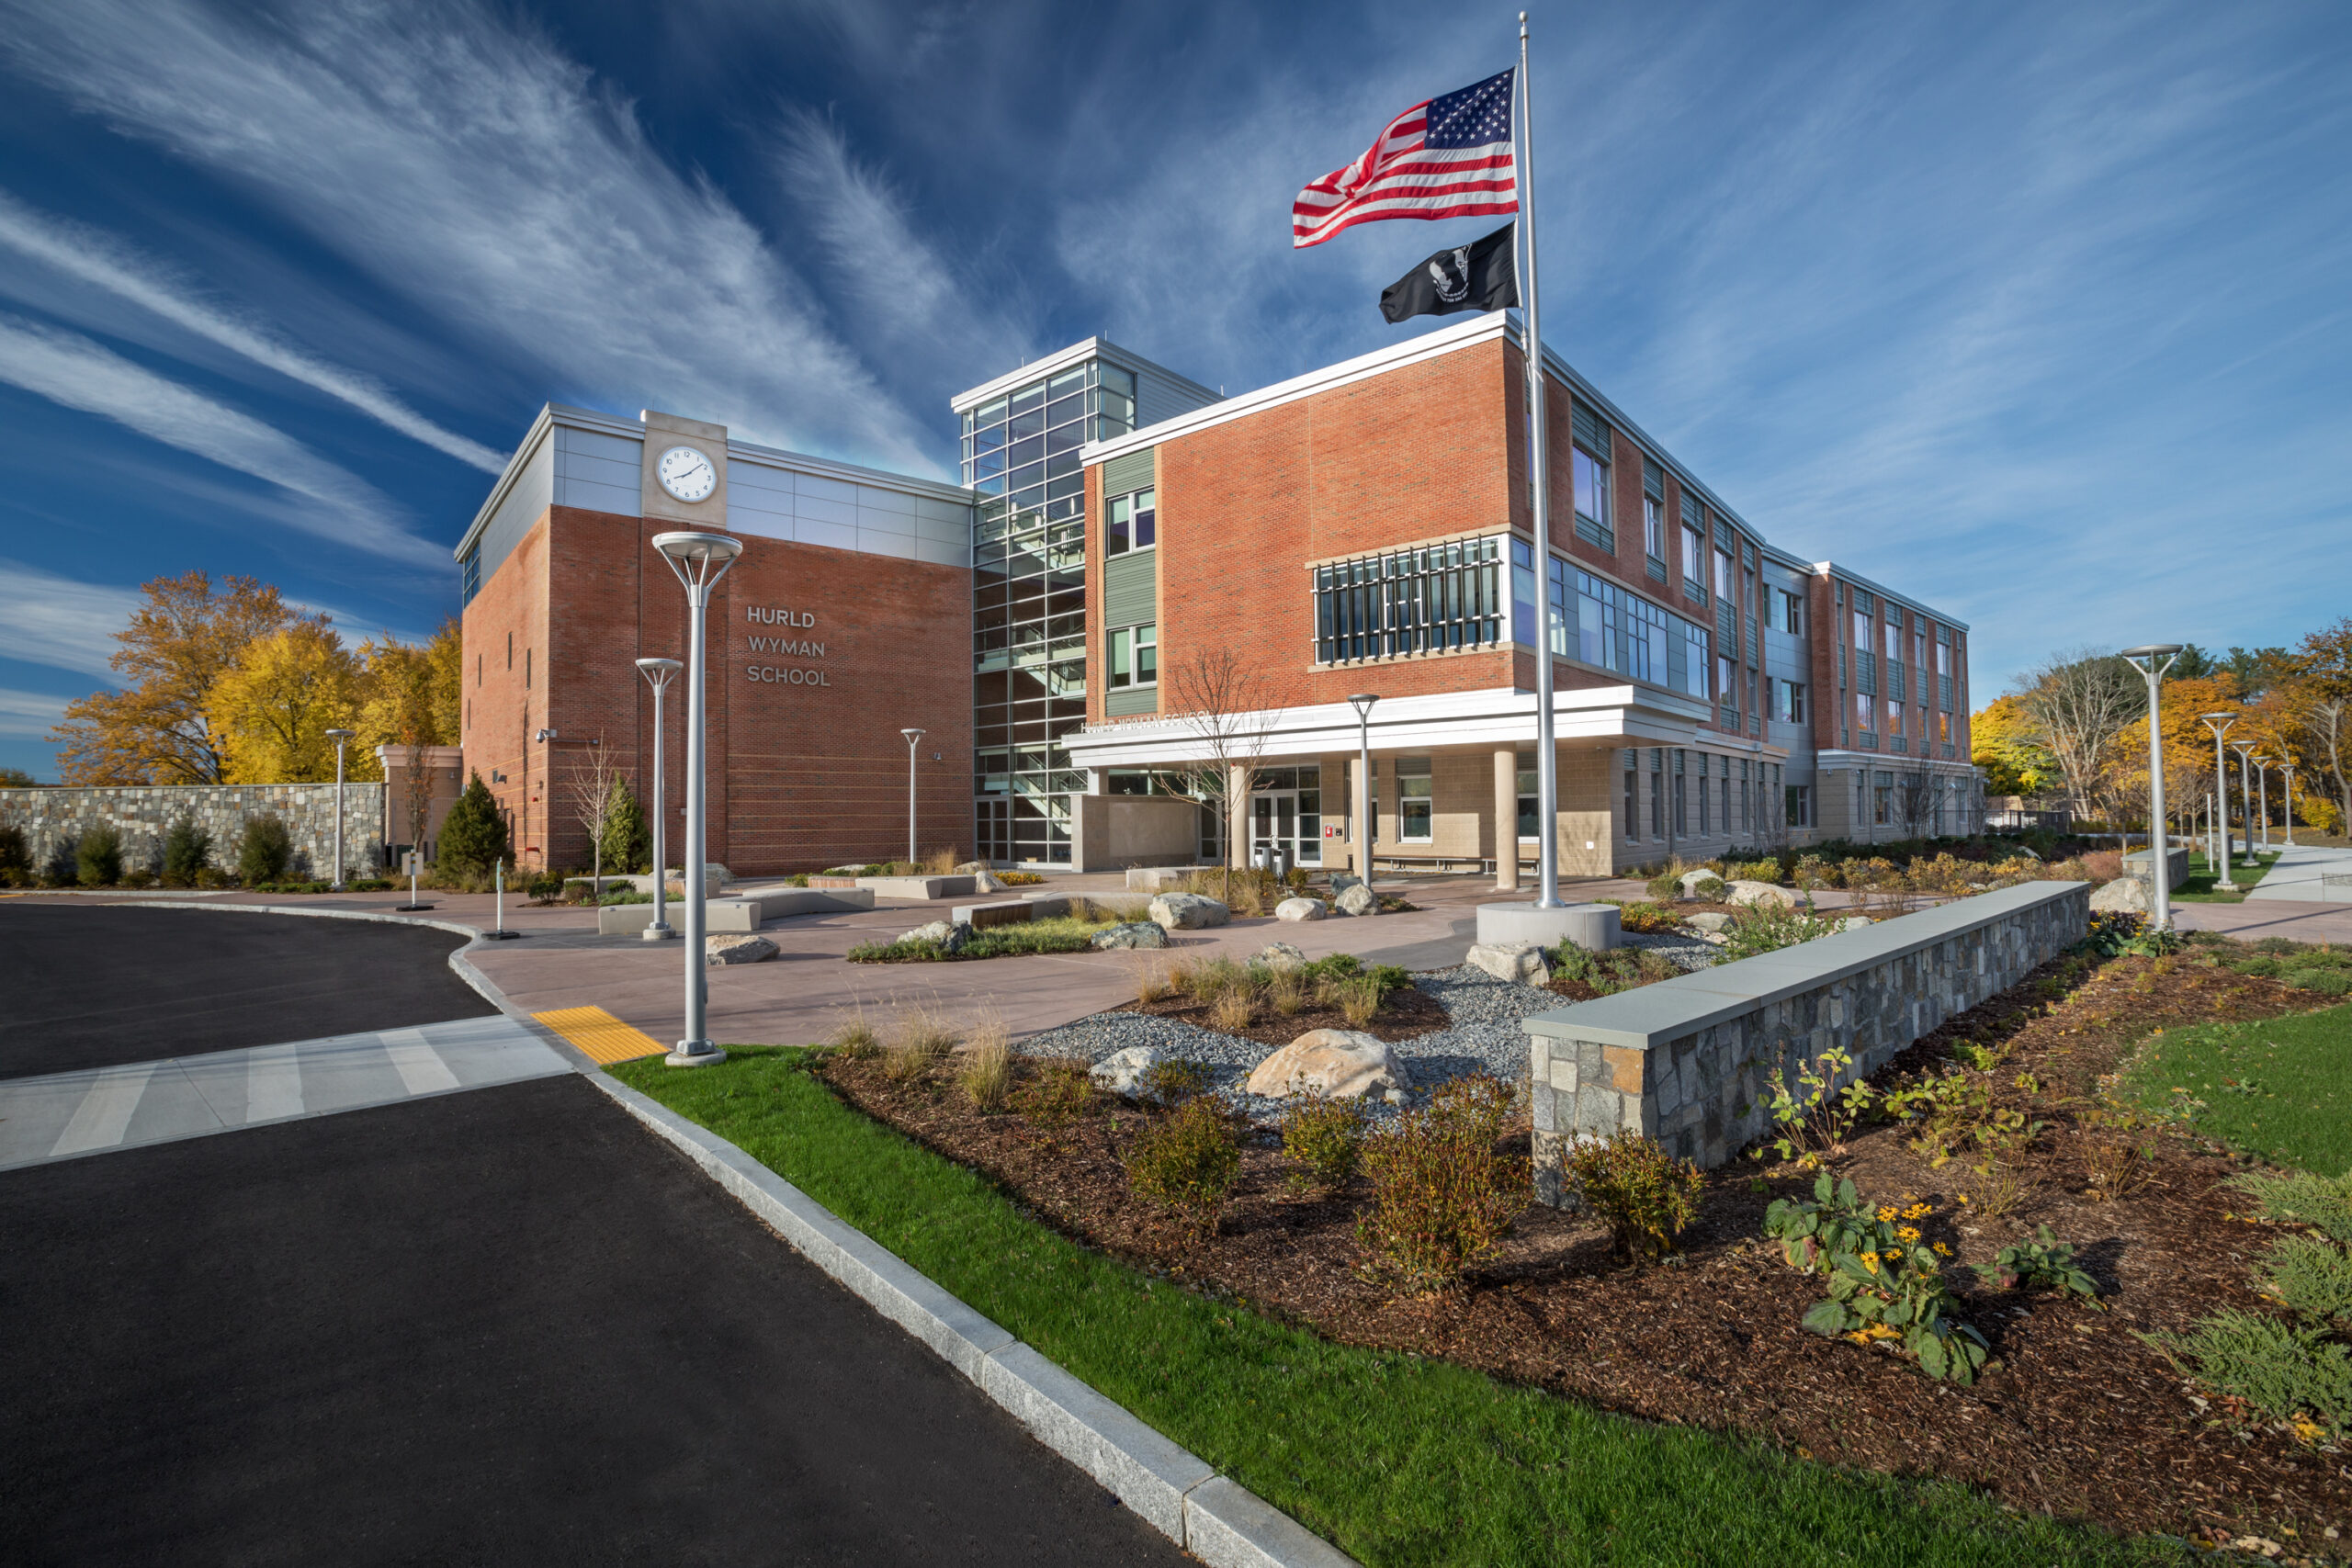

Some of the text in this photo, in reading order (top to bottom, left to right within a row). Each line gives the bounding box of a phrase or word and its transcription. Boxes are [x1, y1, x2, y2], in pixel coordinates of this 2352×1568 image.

[747, 606, 815, 628] HURLD
[748, 635, 825, 658] WYMAN
[747, 666, 831, 687] SCHOOL
[1080, 710, 1213, 734] HURLD WYMAN SCHOOL
